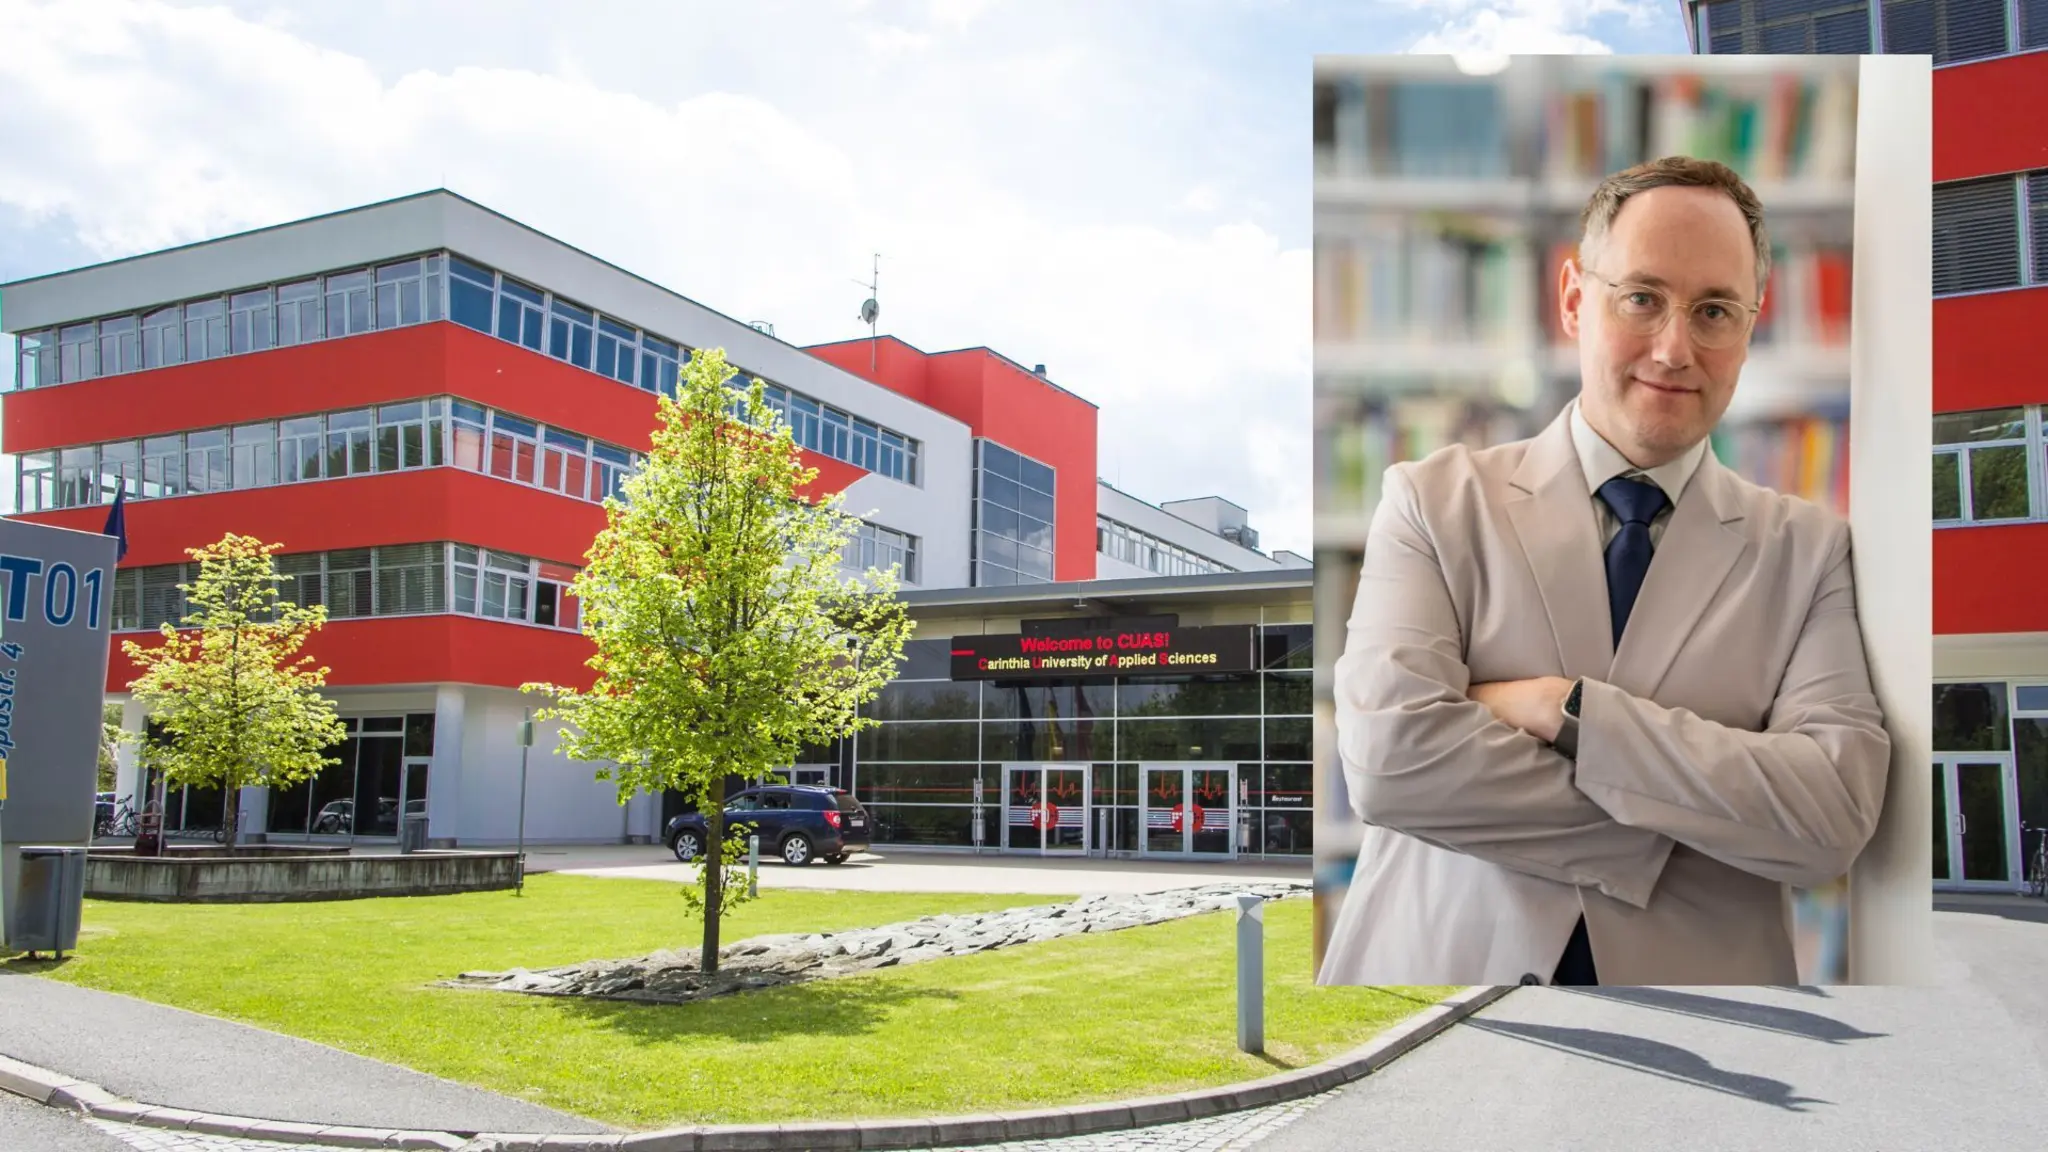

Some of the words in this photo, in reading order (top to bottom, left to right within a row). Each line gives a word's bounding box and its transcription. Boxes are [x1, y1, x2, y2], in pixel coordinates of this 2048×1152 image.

[0, 553, 104, 630] T01
[0, 641, 24, 661] 4
[1020, 636, 1093, 653] Welcome
[1096, 636, 1114, 650] to
[1117, 632, 1170, 649] CUAS!
[978, 657, 1031, 671] Carinthia
[1032, 655, 1092, 669] University
[1094, 654, 1109, 667] of
[1109, 653, 1156, 668] Applied
[1158, 652, 1217, 666] Sciences
